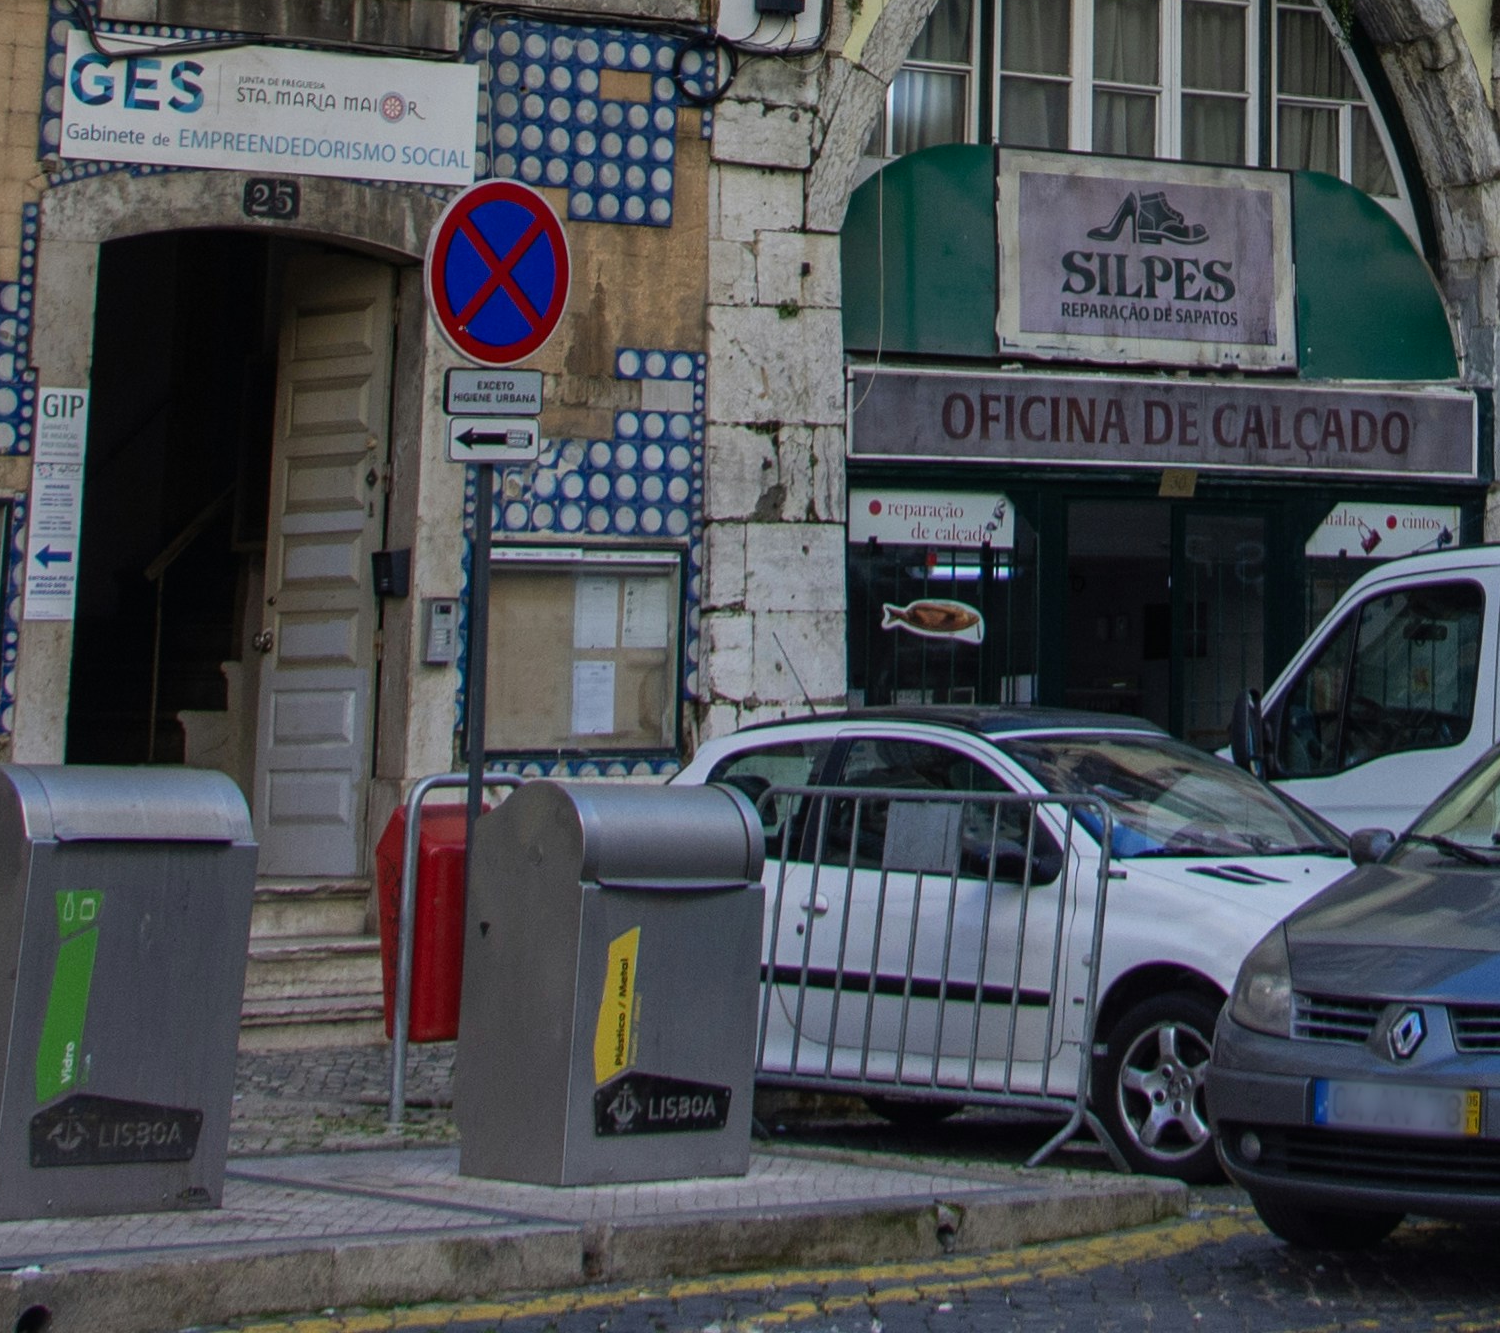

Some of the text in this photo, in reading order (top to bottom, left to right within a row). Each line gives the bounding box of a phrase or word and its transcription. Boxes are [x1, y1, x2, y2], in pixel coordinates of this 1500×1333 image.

[69, 52, 205, 114] GES
[238, 75, 326, 90] JUNTA DE FREGUESIA
[236, 87, 272, 106] STA.
[275, 91, 336, 112] MARIA
[66, 123, 470, 169] Gabinete de EMPREENDEDORISMO SOCIAL
[251, 183, 293, 213] 25
[1061, 251, 1236, 303] SILPES
[1061, 302, 1238, 326] REPARAÇÃO DE SAPATOS
[453, 393, 536, 403] HIGIENE URBANA
[477, 381, 515, 390] EXCETO
[43, 393, 84, 418] GIP
[941, 392, 1410, 465] OFICINA DE CALÇADO
[888, 501, 964, 521] reparação
[1402, 513, 1441, 530] cintos
[911, 522, 993, 544] de calçado
[618, 958, 629, 998] Metal
[615, 1013, 626, 1066] Plástico
[61, 1041, 76, 1084] Vidro
[648, 1094, 716, 1121] LISBOA
[97, 1121, 182, 1149] LISBOA
